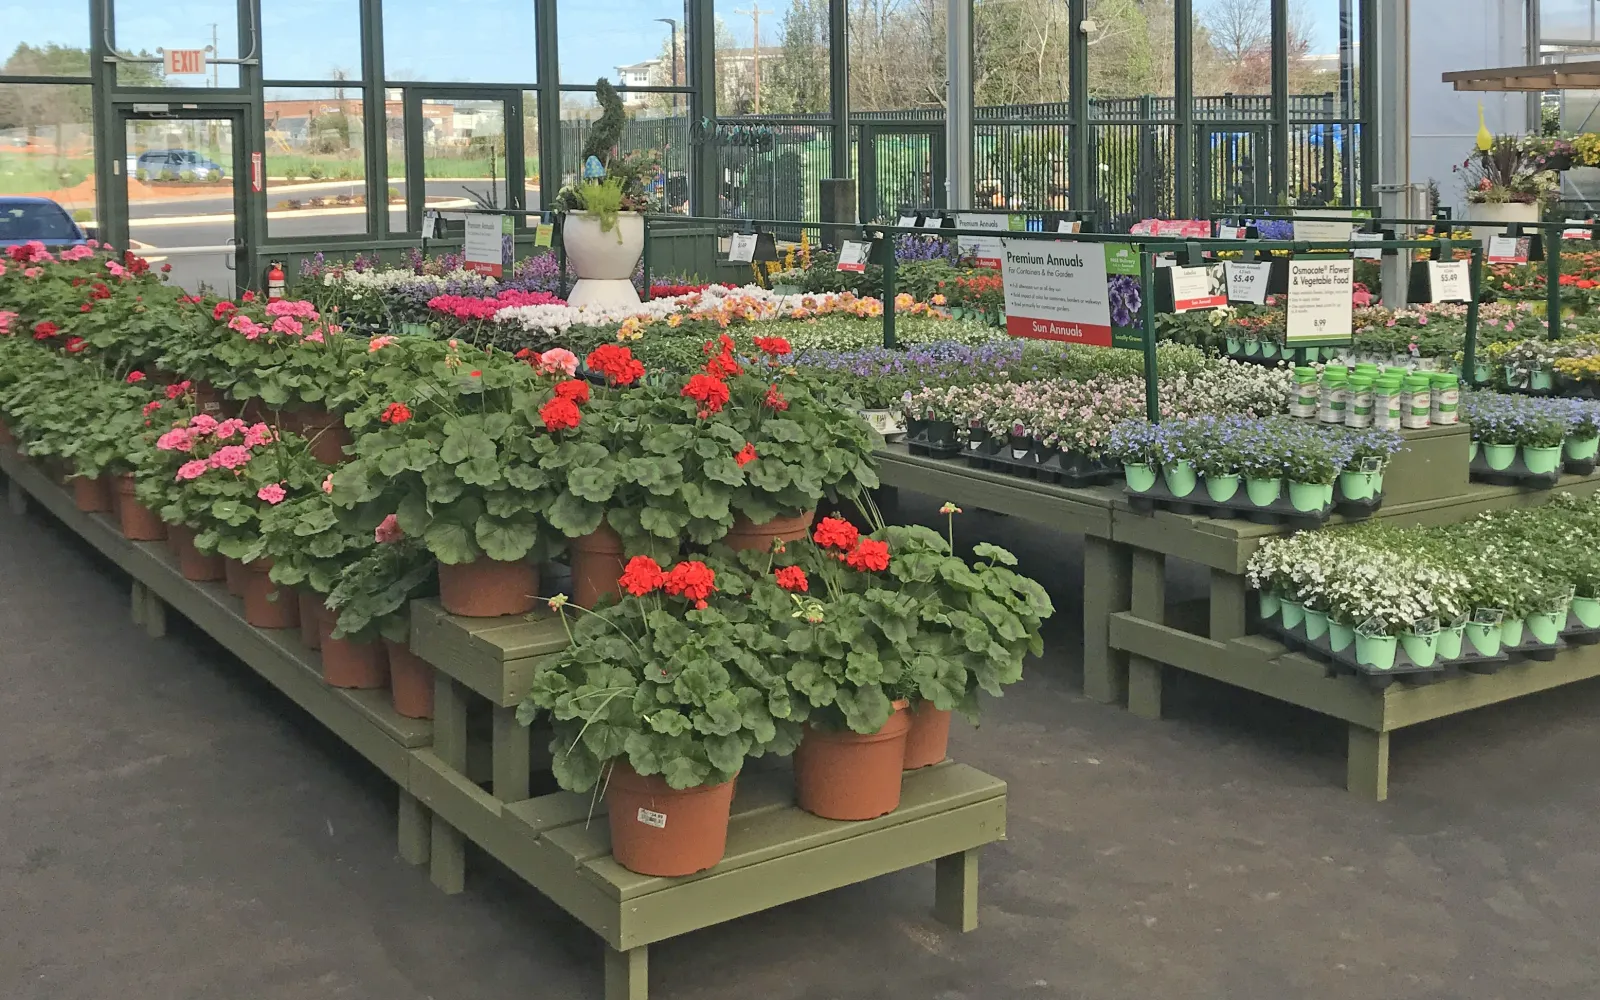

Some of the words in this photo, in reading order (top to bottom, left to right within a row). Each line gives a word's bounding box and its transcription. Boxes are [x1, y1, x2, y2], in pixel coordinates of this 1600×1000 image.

[171, 51, 200, 72] EXIT
[1006, 252, 1044, 264] Premium
[1047, 253, 1084, 267] Annuals
[1016, 267, 1040, 276] Containers
[1329, 265, 1350, 274] Flower
[1293, 276, 1298, 285] &
[1300, 275, 1332, 287] Vegetable
[1334, 275, 1349, 284] Food
[1032, 321, 1047, 332] Sun
[1050, 323, 1082, 337] Annuals
